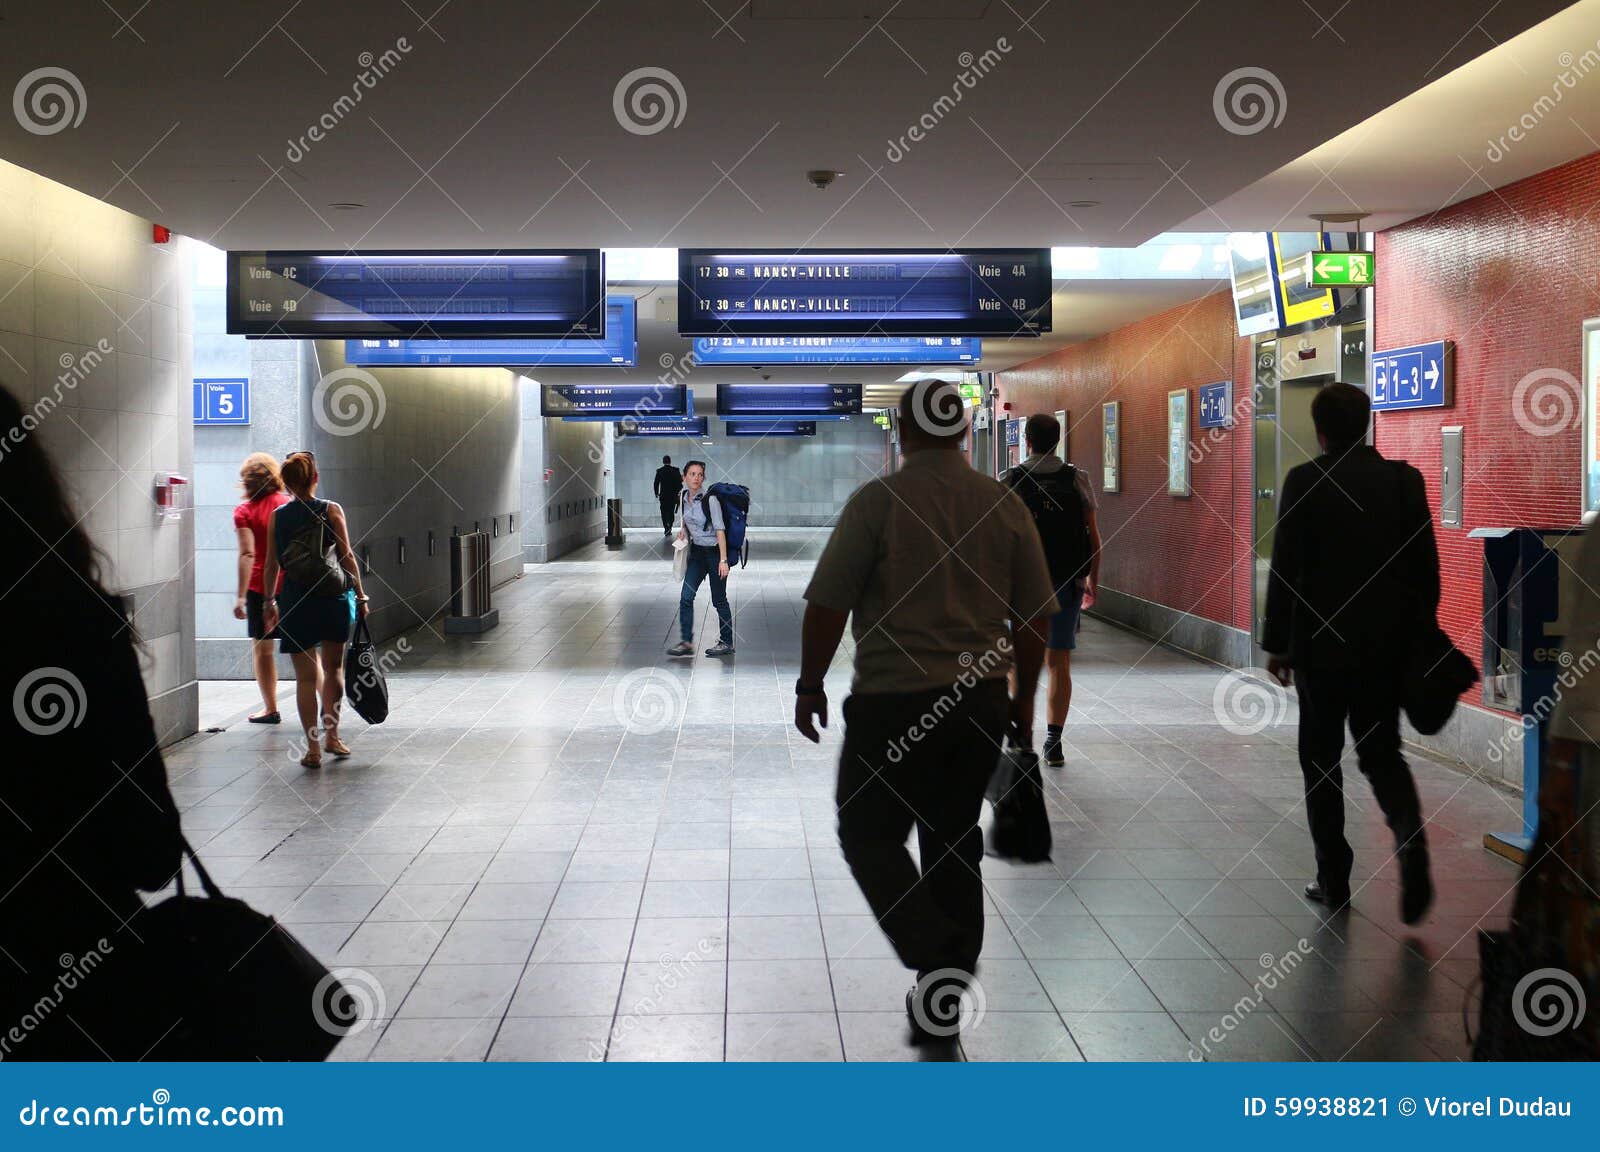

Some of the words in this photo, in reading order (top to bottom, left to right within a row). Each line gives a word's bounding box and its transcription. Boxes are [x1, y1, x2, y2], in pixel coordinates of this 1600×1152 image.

[250, 267, 272, 279] Voie
[282, 267, 297, 279] 4C
[700, 267, 710, 278] 17
[717, 267, 729, 278] 30
[735, 268, 746, 276] RE
[754, 266, 850, 278] NANCY-VILLE
[979, 265, 1001, 277] Voie
[1012, 265, 1026, 277] 4A
[250, 300, 272, 312] Voie
[282, 300, 297, 312] 4D
[700, 299, 710, 310] 17
[717, 299, 729, 310] 30
[735, 301, 746, 309] RE
[754, 298, 850, 310] NANCY-VILLE
[979, 298, 1001, 311] Voie
[1012, 299, 1026, 311] 4B
[709, 337, 719, 347] 17
[925, 337, 943, 346] Voie
[1393, 366, 1419, 397] 1-3
[219, 393, 234, 415] 5
[1209, 397, 1225, 419] 7-10
